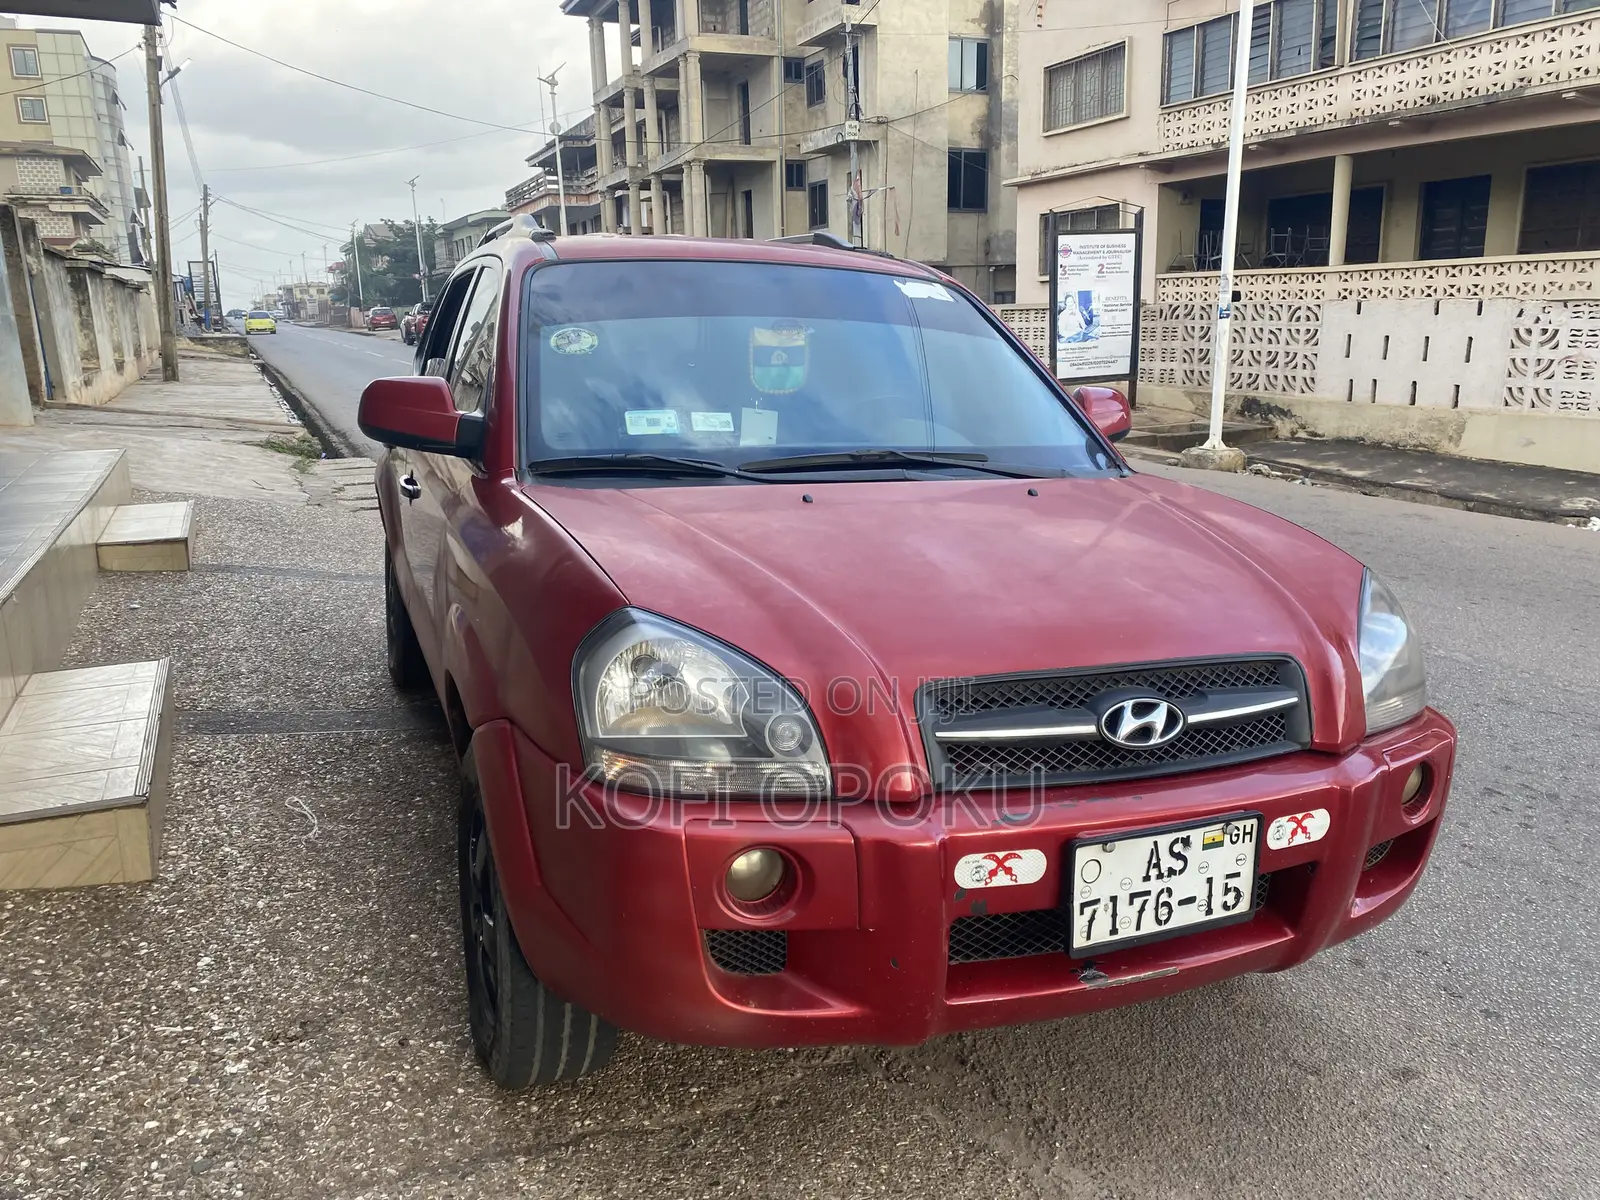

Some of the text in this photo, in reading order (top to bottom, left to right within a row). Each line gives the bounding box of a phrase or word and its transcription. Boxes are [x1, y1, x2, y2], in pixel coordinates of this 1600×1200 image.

[1097, 263, 1105, 275] 2
[1142, 824, 1254, 882] AS GH
[1079, 871, 1243, 941] 7176-15
